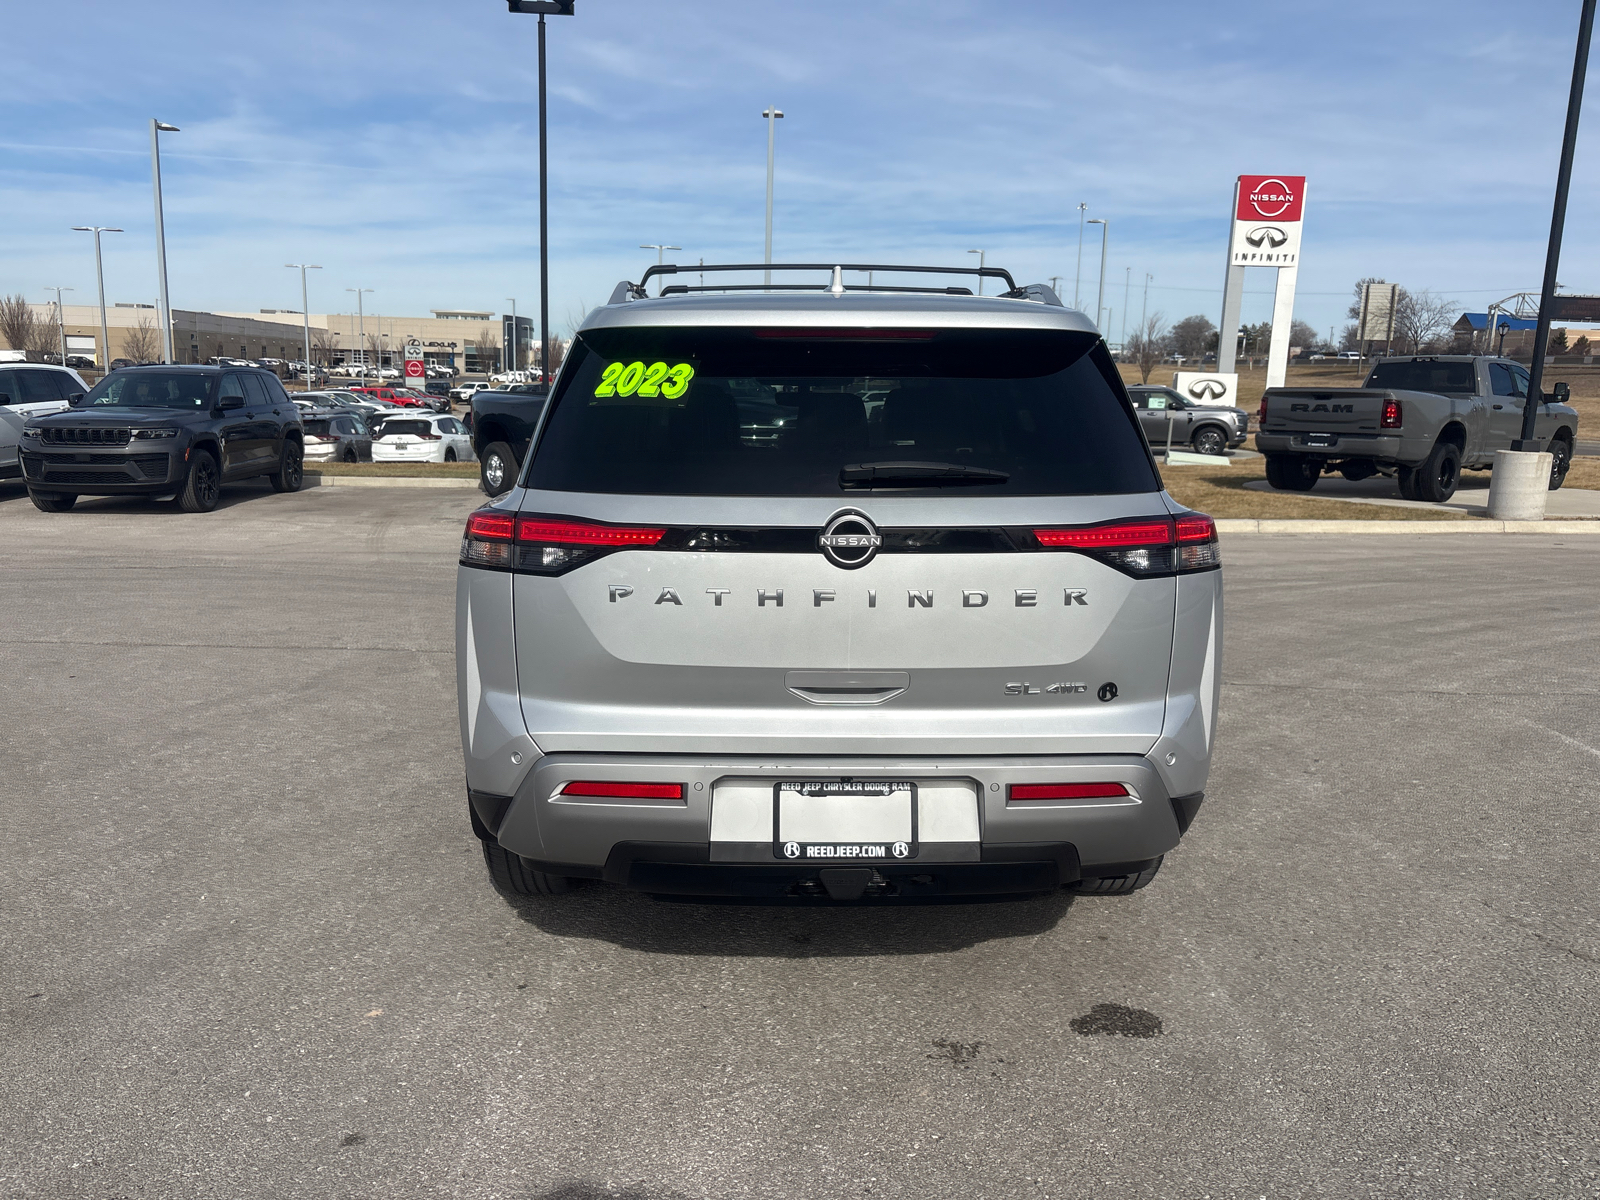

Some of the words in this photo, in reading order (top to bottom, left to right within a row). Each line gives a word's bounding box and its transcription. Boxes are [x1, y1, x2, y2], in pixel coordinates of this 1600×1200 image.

[1250, 194, 1294, 202] NISSAN
[1234, 253, 1295, 262] INFINITI
[594, 361, 695, 400] 2023
[1290, 403, 1354, 414] RAM
[820, 537, 880, 546] NISSAN
[608, 584, 1089, 608] PATHFINDER
[1003, 682, 1041, 696] SL
[1045, 682, 1088, 695] 4WD
[781, 782, 801, 791] REED
[803, 782, 821, 791] JEEP
[823, 782, 863, 791] CHRYSLER
[864, 782, 890, 791] DODGE
[891, 782, 911, 791] RAM
[806, 845, 886, 858] REEDJEEP.COM
